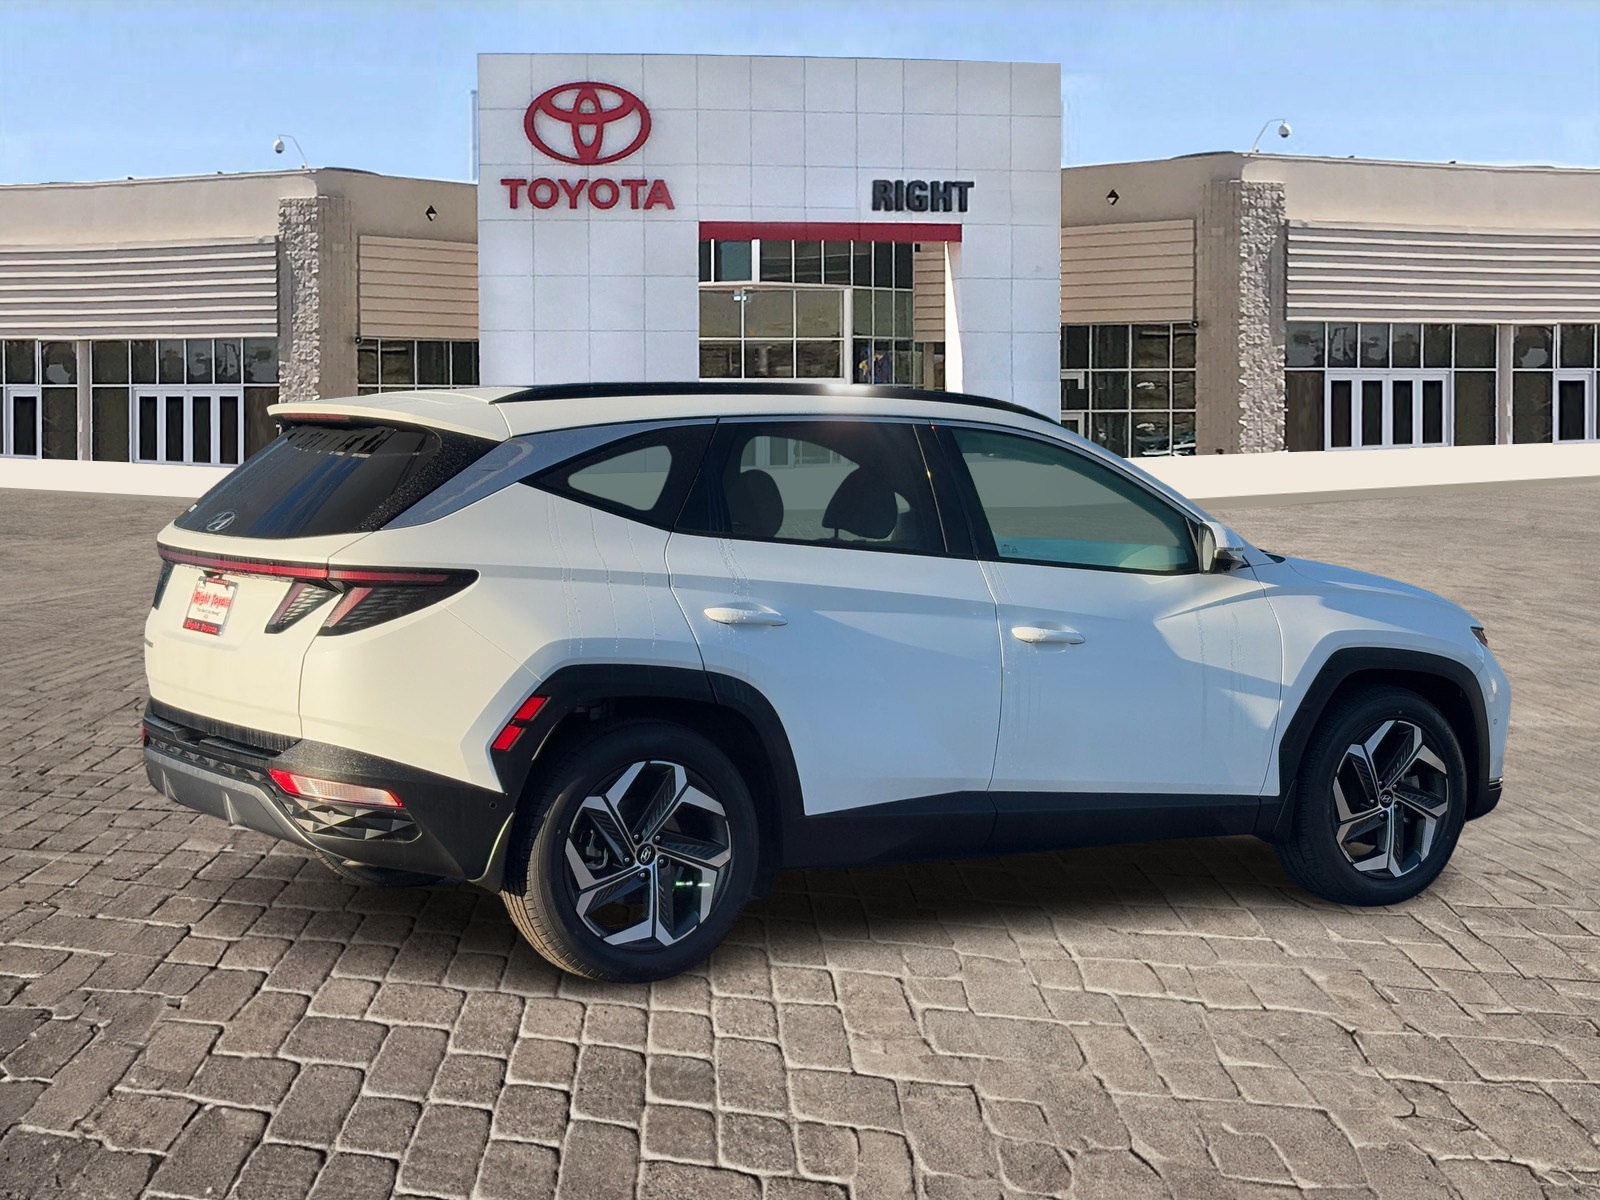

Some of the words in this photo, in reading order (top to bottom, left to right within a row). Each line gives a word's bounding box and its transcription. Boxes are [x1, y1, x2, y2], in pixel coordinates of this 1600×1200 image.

[500, 177, 675, 210] TOYOTA
[872, 179, 975, 212] RIGHT
[193, 591, 210, 605] Right
